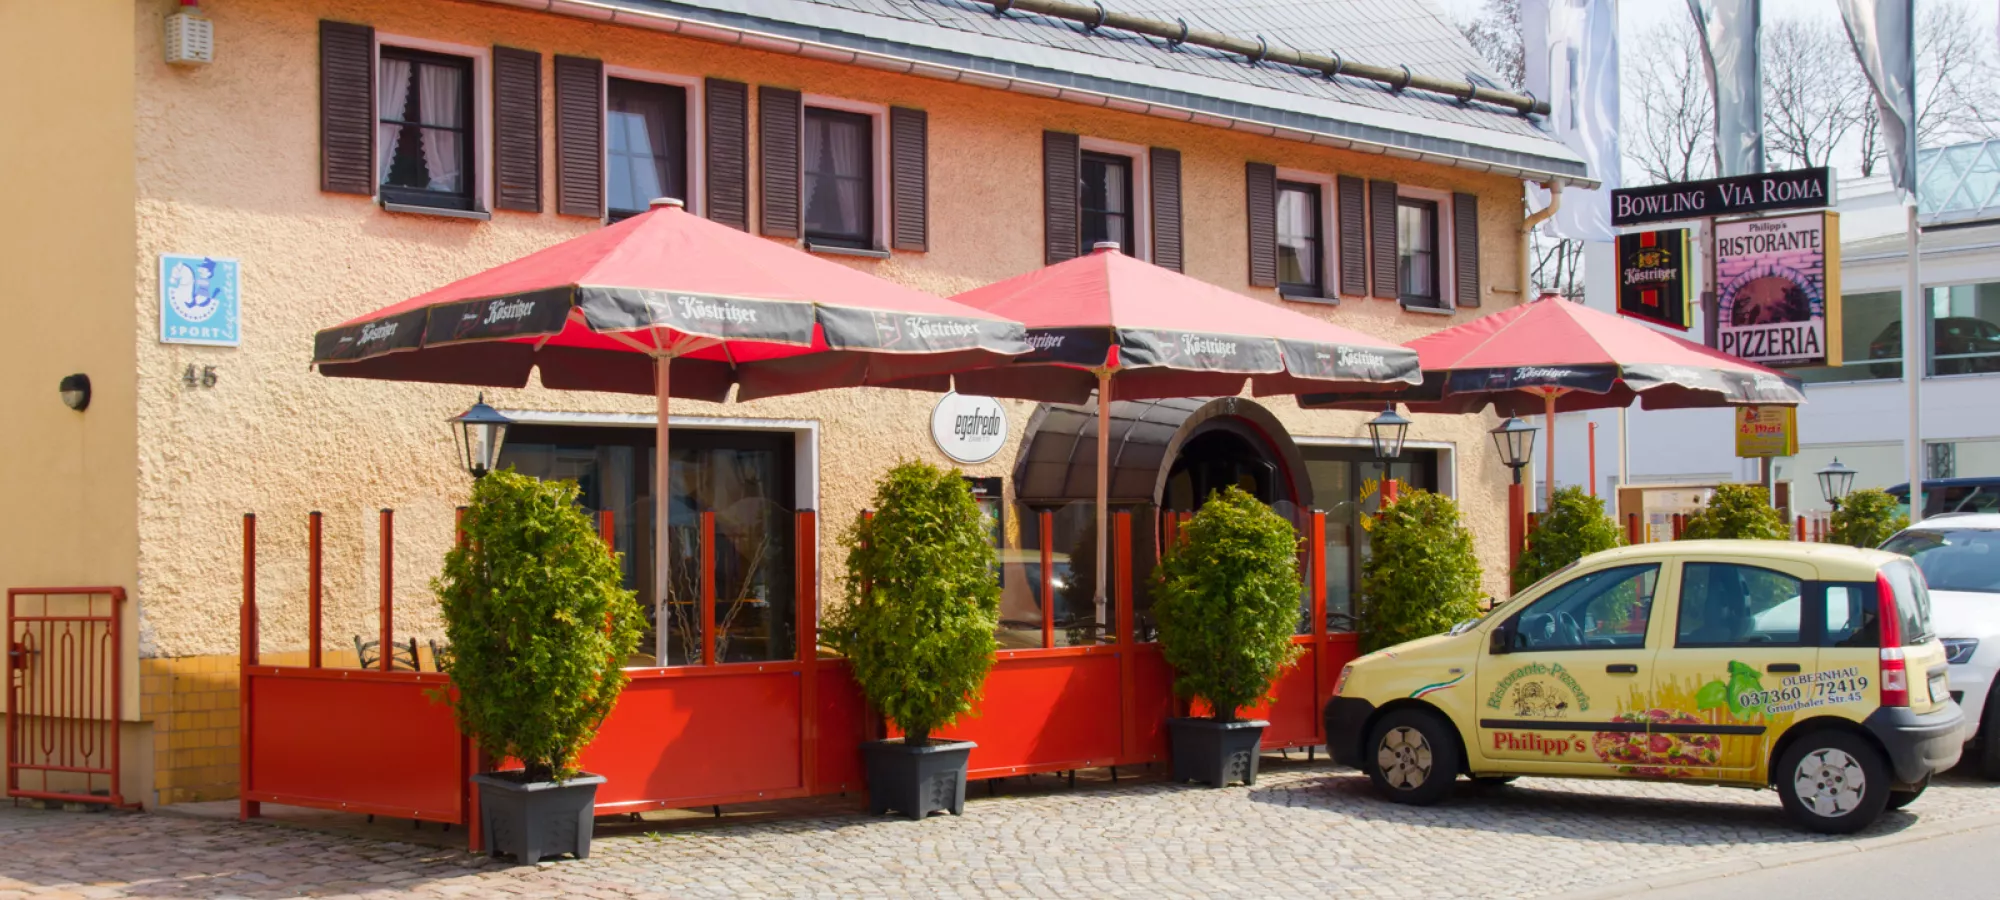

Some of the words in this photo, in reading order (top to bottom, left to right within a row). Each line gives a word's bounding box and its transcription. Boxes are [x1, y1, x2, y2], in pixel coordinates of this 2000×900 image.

[1719, 229, 1820, 257] RISTORANTE
[1624, 267, 1677, 285] Köstritzer
[484, 299, 536, 325] Köstritzer
[678, 296, 756, 324] Köstritzer
[169, 326, 219, 338] SPORT
[905, 316, 980, 338] Köstritzer
[1181, 333, 1237, 357] Köstritzer
[1721, 326, 1820, 358] PIZZERIA
[182, 362, 219, 389] 45
[1782, 667, 1859, 686] OLBERNHAU
[1740, 686, 1801, 708] 037360
[1815, 676, 1869, 697] 72419
